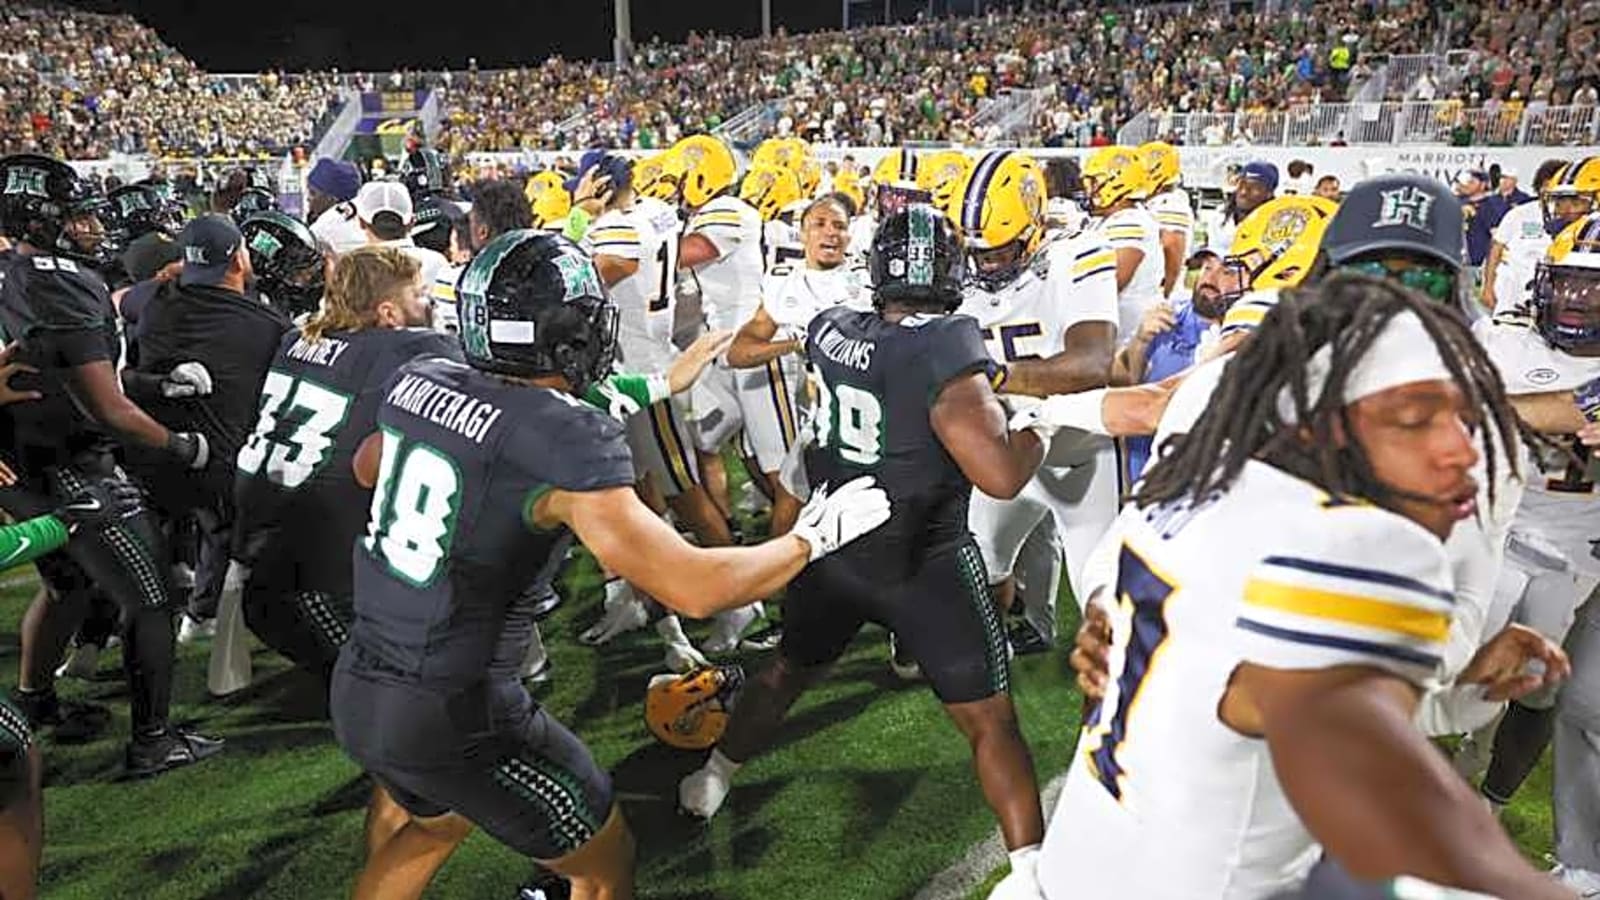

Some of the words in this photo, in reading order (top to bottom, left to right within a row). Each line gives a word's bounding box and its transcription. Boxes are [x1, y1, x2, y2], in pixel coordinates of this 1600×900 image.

[1398, 153, 1488, 164] MARRIOTT
[1371, 186, 1436, 235] H
[648, 240, 670, 312] 1
[820, 327, 875, 371] WILLIAMS
[236, 370, 350, 488] 33
[387, 373, 502, 443] MARITERAGI
[364, 429, 458, 583] 18
